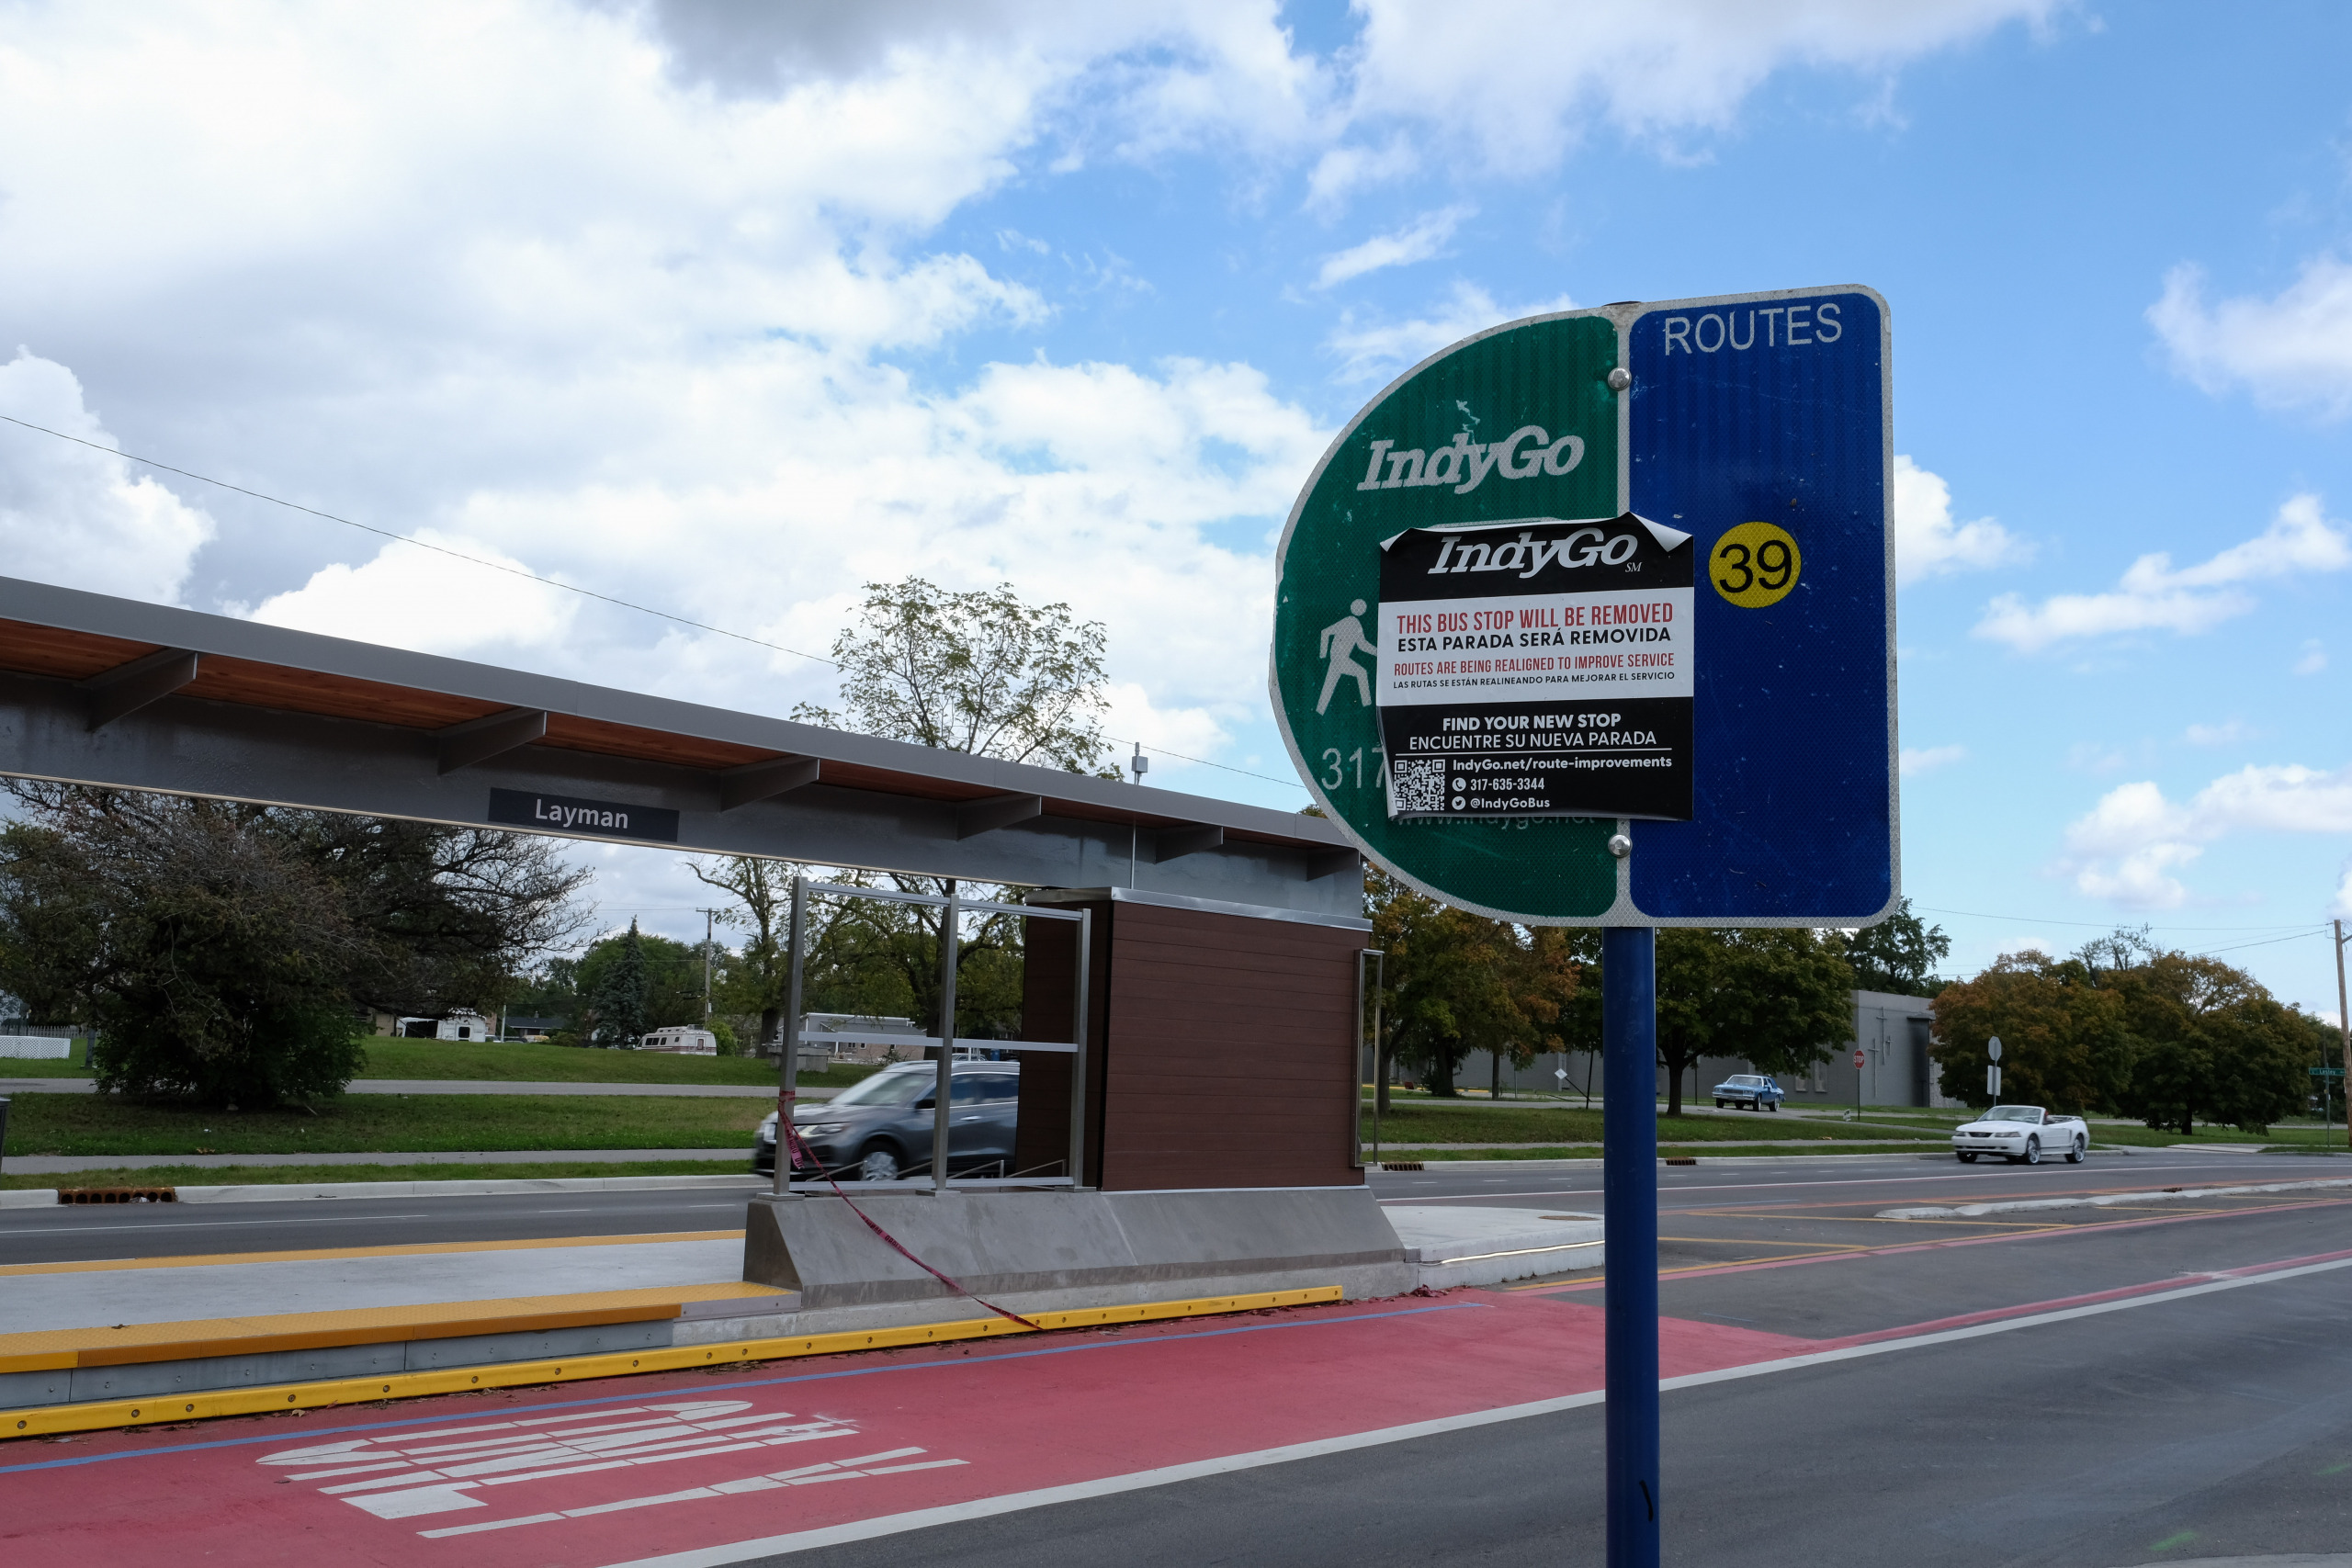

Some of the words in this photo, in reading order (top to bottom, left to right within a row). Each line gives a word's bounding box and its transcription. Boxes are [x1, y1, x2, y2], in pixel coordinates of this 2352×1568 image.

[1665, 302, 1842, 356] ROUTES
[1356, 424, 1585, 495] IndyGo
[1427, 527, 1638, 579] IndyGo
[1625, 561, 1642, 573] SM
[1719, 539, 1792, 593] 39
[1396, 614, 1432, 635] THIS
[1437, 612, 1468, 633] BUS
[1473, 610, 1514, 631] STOP
[1519, 608, 1559, 629] WILL
[1565, 606, 1586, 627] BE
[1591, 603, 1673, 626] REMOVED
[1397, 637, 1438, 652] ESTA
[1442, 634, 1514, 650] PARADA
[1519, 627, 1565, 648] SERÁ
[1570, 626, 1671, 645] REMOVIDA
[1394, 661, 1434, 676] ROUTES
[1436, 660, 1457, 675] ARE
[1460, 659, 1492, 673] BEING
[1495, 657, 1555, 672] REALIGNED
[1557, 656, 1571, 670] TO
[1574, 654, 1624, 670] IMPROVE
[1627, 652, 1675, 668] SERVICE
[1393, 681, 1409, 689] LAS
[1410, 680, 1438, 688] RUTAS
[1439, 679, 1450, 687] SE
[1451, 677, 1478, 687] ESTÁN
[1480, 676, 1543, 685] REALINEANDO
[1545, 675, 1569, 683] PARA
[1571, 673, 1617, 682] MEJORAR
[1619, 672, 1629, 681] EL
[1631, 671, 1675, 681] SERVICIO
[1442, 716, 1481, 731] FIND
[1484, 716, 1530, 730] YOUR
[1533, 714, 1574, 729] NEW
[1577, 713, 1622, 728] STOP
[1409, 734, 1501, 750] ENCUENTRE
[1505, 733, 1526, 748] SU
[1530, 732, 1585, 748] NUEVA
[1589, 730, 1657, 746] PARADA
[1453, 756, 1673, 773] IndyGo.net/route-improvements
[1470, 777, 1545, 791] 317-635-3344
[535, 798, 629, 829] Layman
[1470, 797, 1551, 811] @IndyGoBus
[254, 1399, 972, 1540] ONLY
